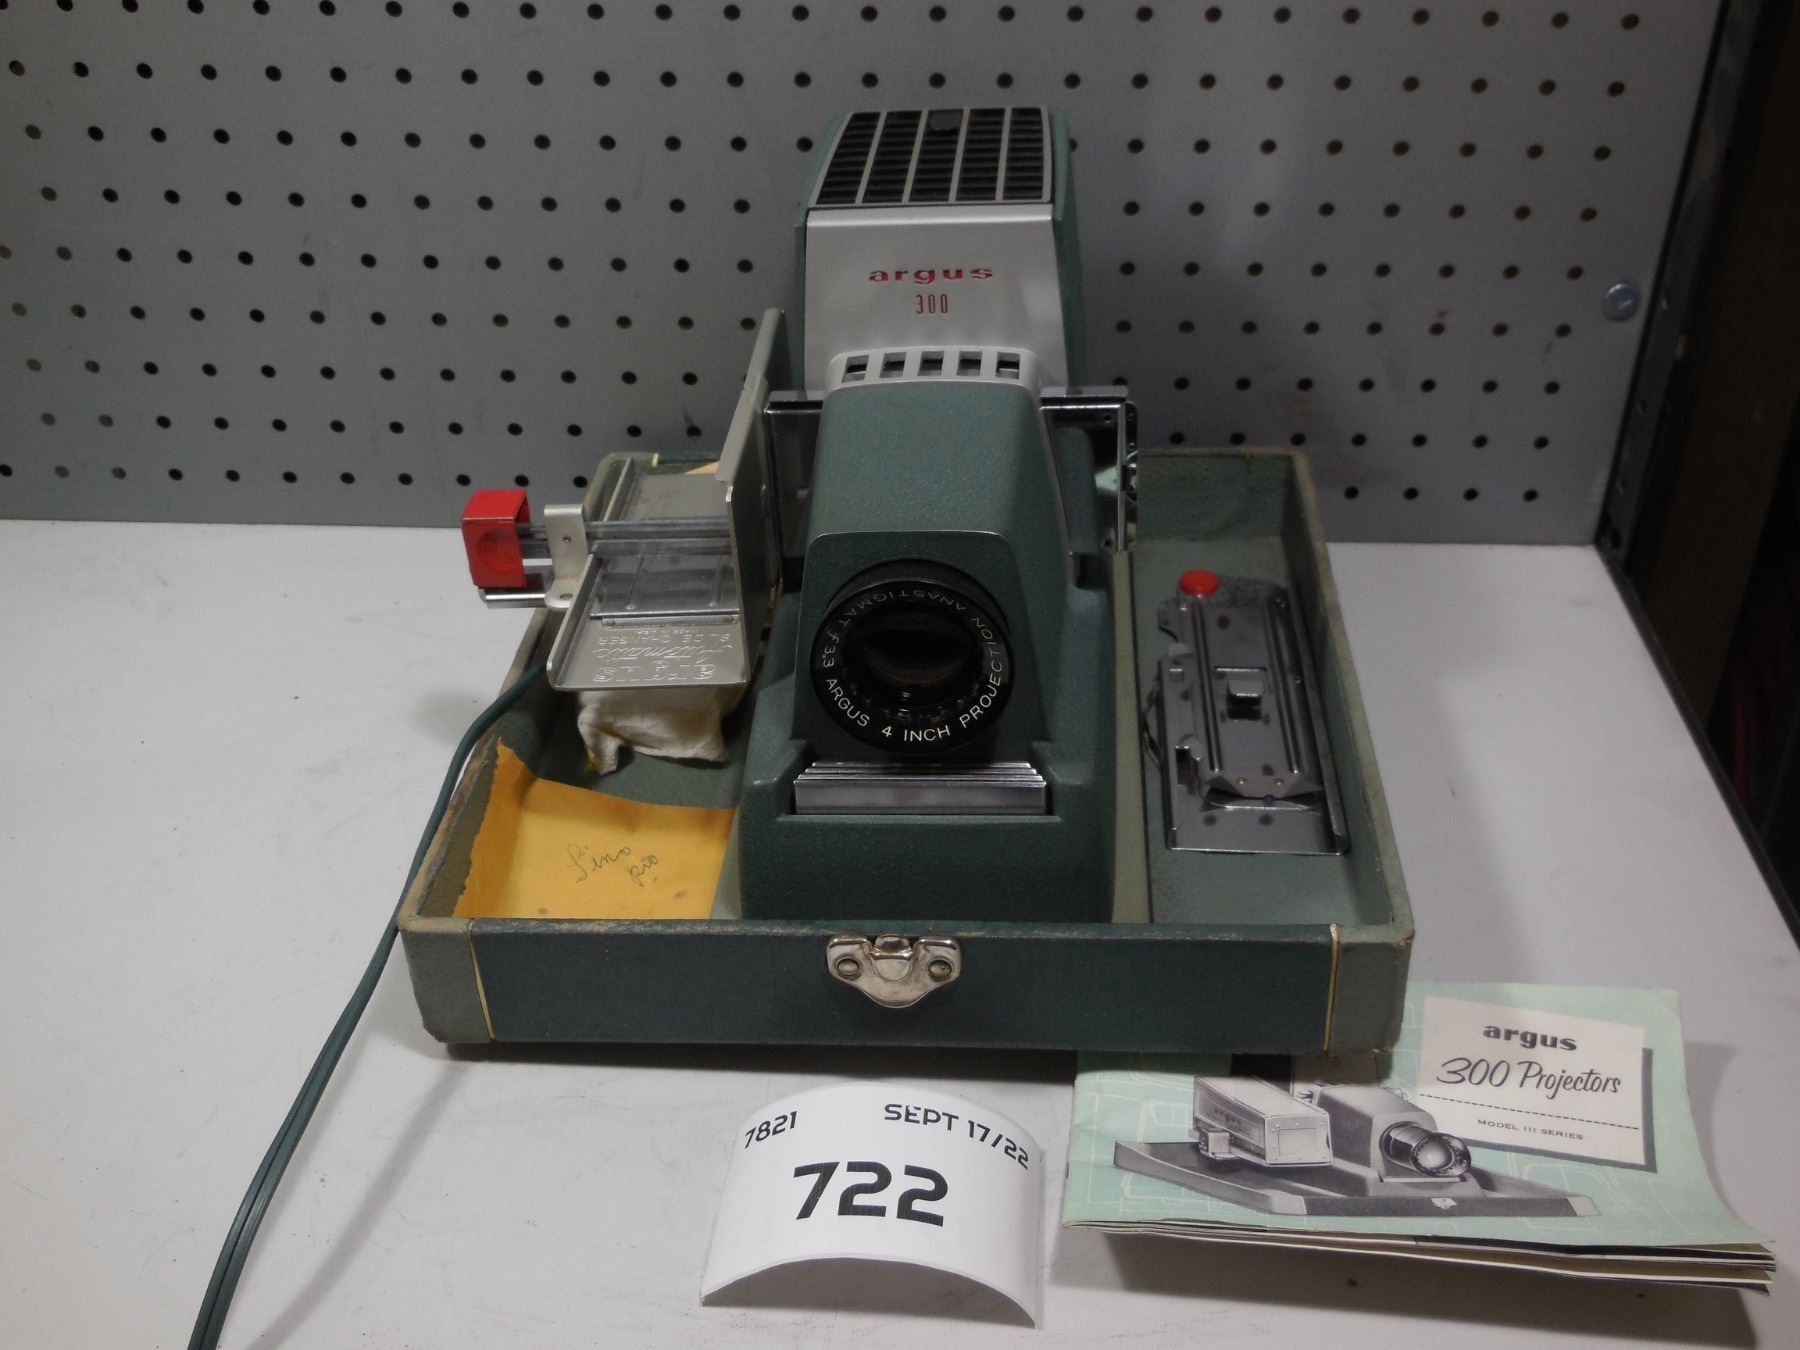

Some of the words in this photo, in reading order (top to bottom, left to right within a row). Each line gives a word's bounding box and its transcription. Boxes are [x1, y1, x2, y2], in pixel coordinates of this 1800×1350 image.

[869, 268, 993, 284] argus
[916, 294, 948, 314] 300
[838, 589, 967, 629] ANASTIGMAT
[591, 644, 734, 664] Automatic
[958, 617, 1003, 728] PROJECTION
[825, 677, 870, 727] ARGUS
[881, 726, 893, 738] 4
[903, 724, 950, 743] INCH
[1482, 1025, 1577, 1051] argus
[1436, 1057, 1510, 1088] 300
[1517, 1060, 1622, 1100] Projectors
[744, 1111, 798, 1149] 7821
[885, 1104, 959, 1131] SEPT
[967, 1120, 1029, 1170] 17/22
[1477, 1119, 1520, 1132] MODEL
[1541, 1128, 1584, 1140] SERIES
[793, 1161, 948, 1227] 722
